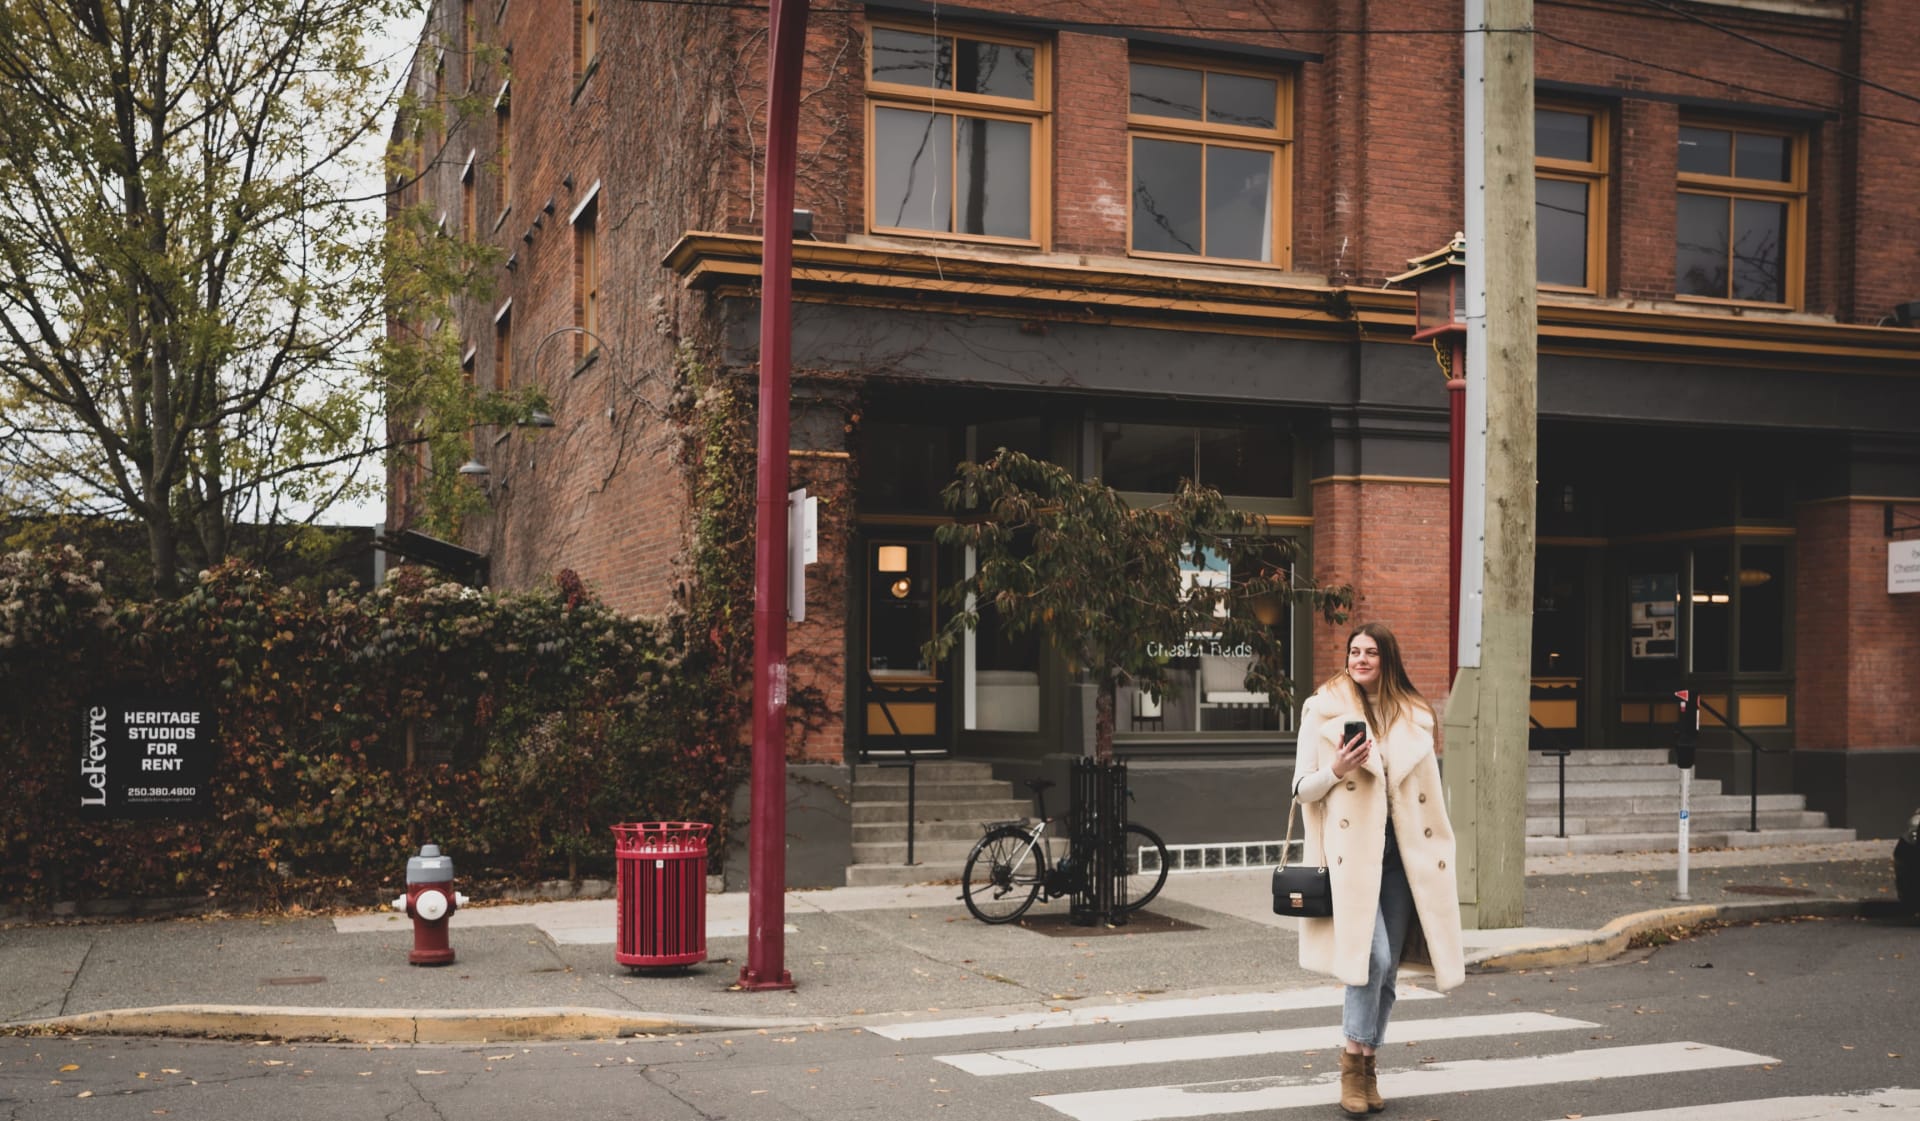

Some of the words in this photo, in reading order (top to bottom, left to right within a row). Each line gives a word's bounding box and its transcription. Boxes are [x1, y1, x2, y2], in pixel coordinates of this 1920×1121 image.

[124, 712, 200, 724] HERITAGE
[128, 727, 196, 740] STUDIOS
[147, 743, 177, 755] FOR
[81, 706, 107, 807] LeFevre
[141, 758, 183, 771] RENT
